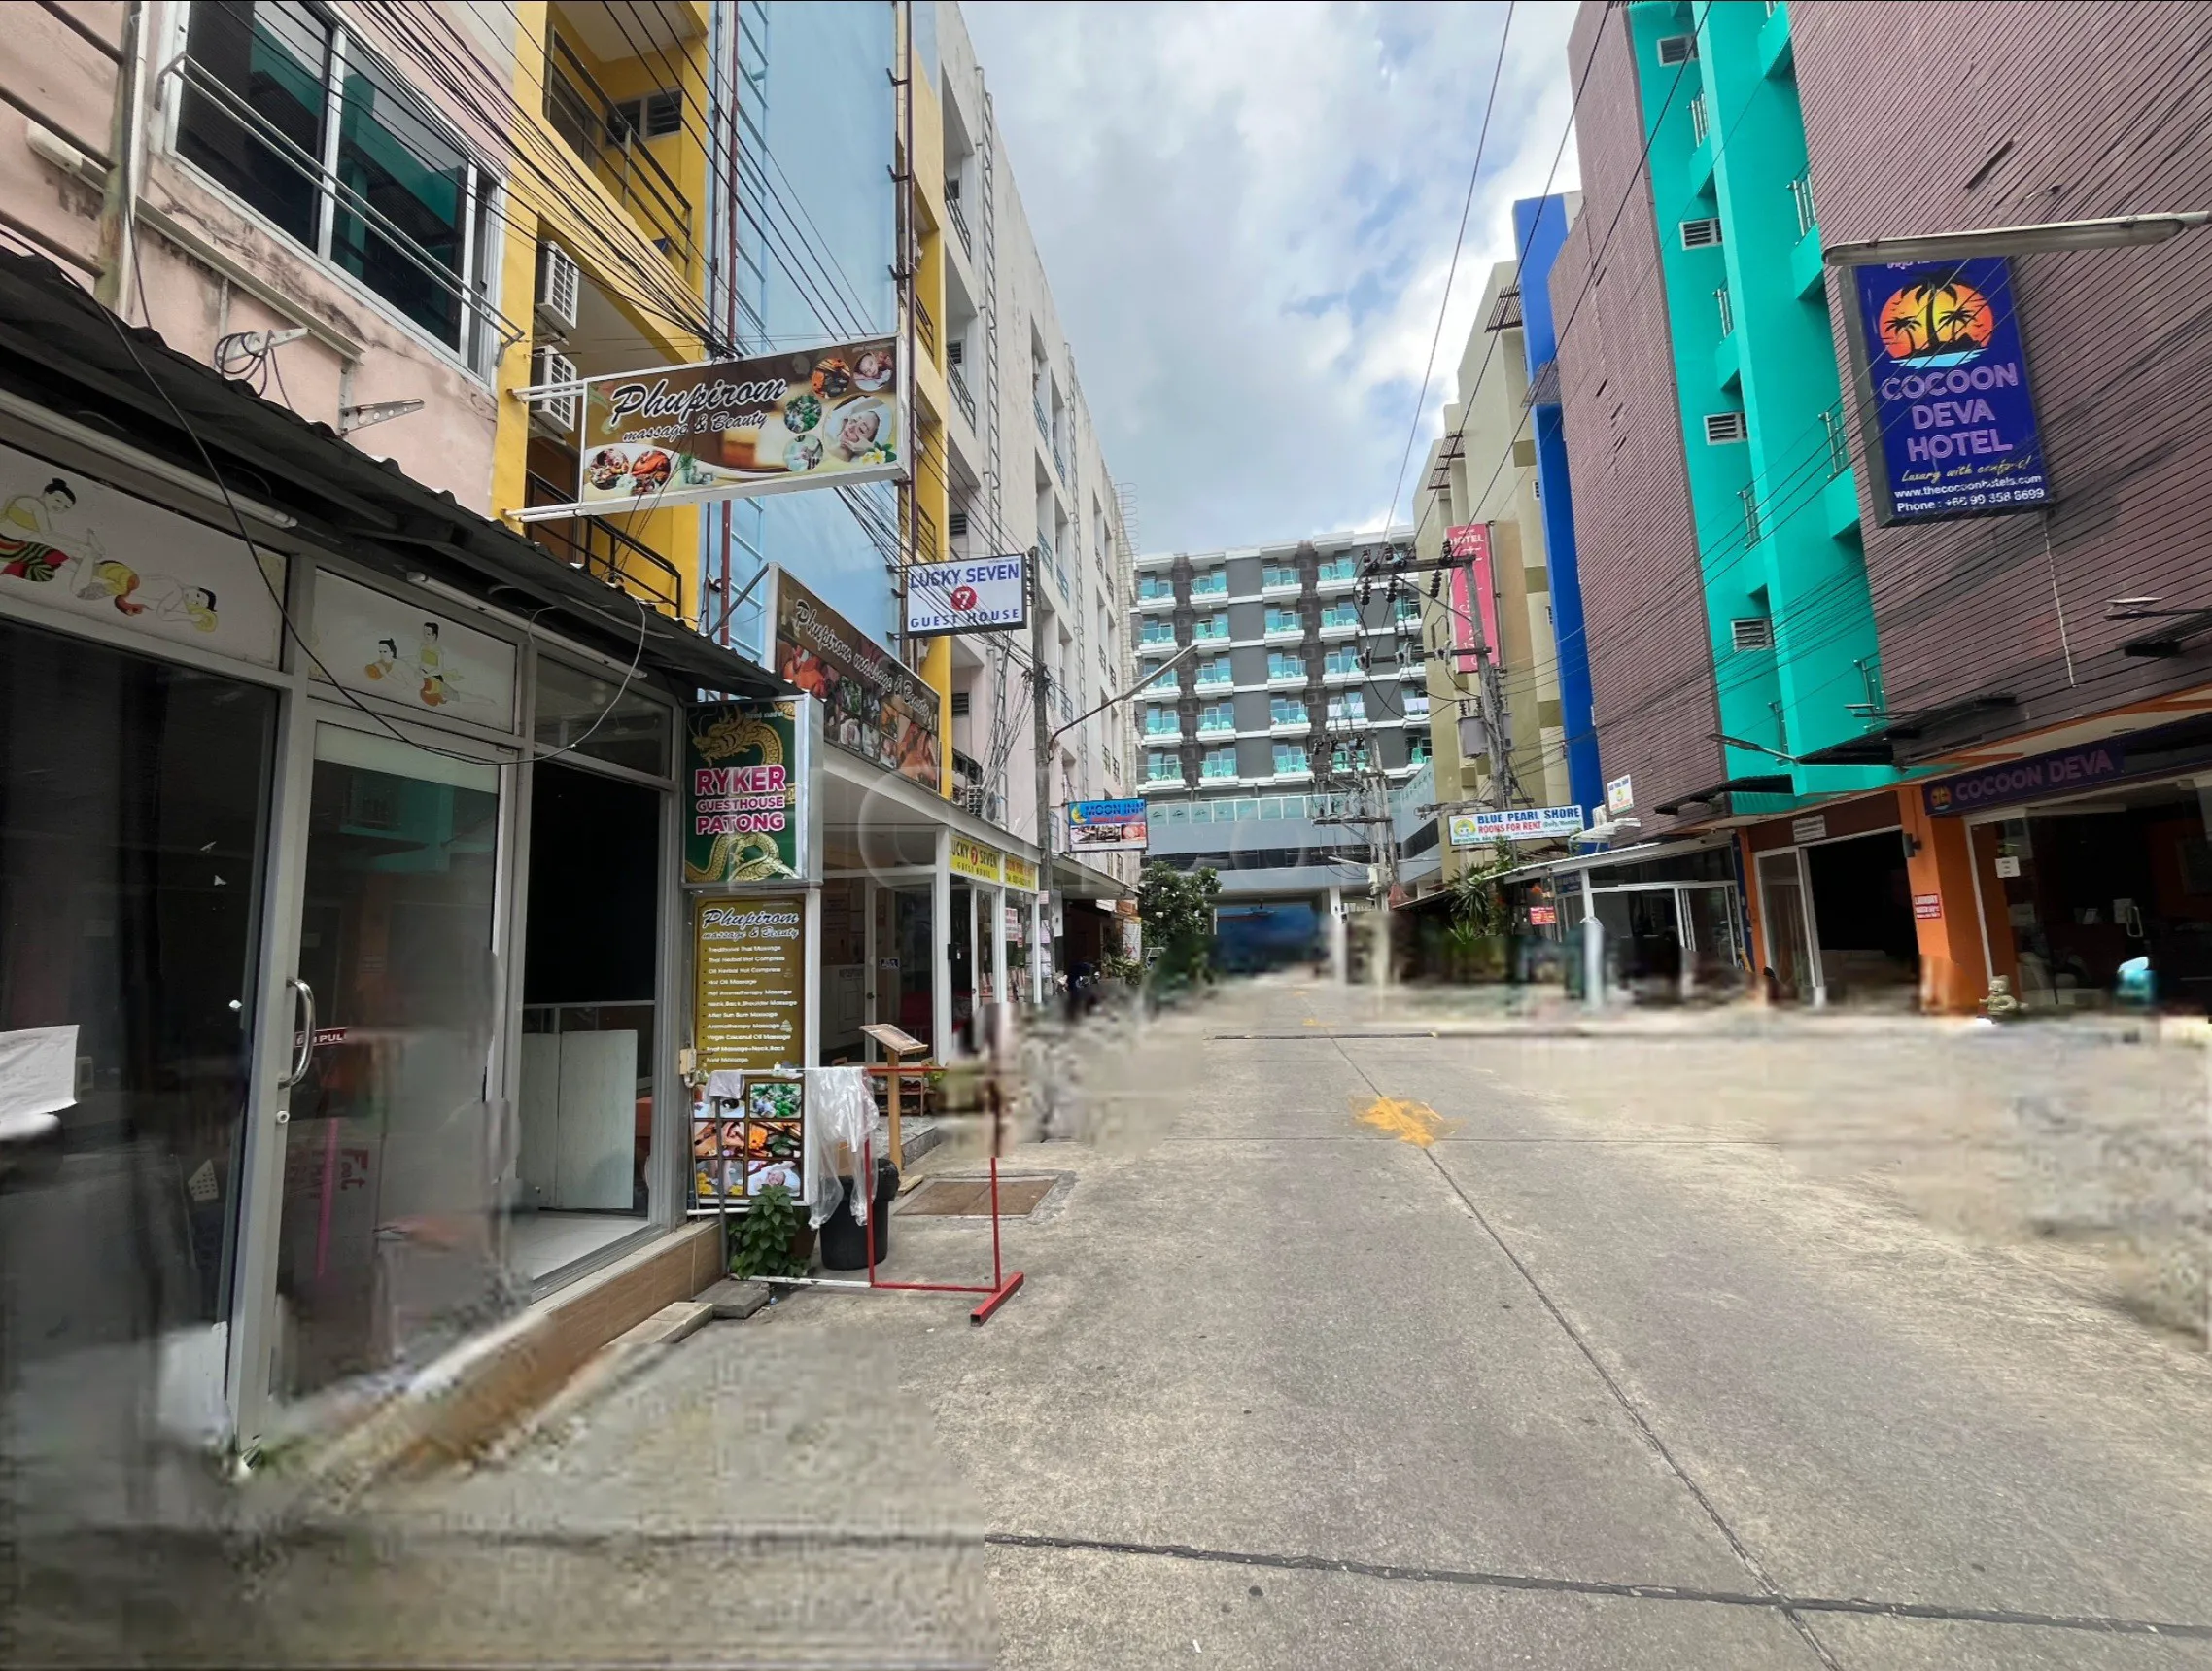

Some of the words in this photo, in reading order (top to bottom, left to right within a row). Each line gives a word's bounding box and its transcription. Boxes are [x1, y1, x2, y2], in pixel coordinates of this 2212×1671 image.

[1881, 362, 2019, 400] COCOON
[610, 378, 788, 426] Phupirom
[1911, 399, 1996, 429] DEVA
[622, 422, 689, 443] massage
[694, 413, 709, 434] &
[710, 409, 768, 431] Beauty
[1907, 429, 2014, 462] HOTEL
[1897, 501, 1936, 512] Phone
[910, 569, 961, 589] LUCKY
[966, 563, 1020, 583] SEVEN
[911, 614, 959, 628] GUEST
[968, 609, 1020, 624] HOUSE
[696, 765, 786, 795] RYKER
[1955, 764, 2043, 801] COCOON
[2048, 749, 2115, 783] DEVA
[697, 796, 785, 813] GUESTHOUSE
[1085, 803, 1122, 815] MOON
[1477, 813, 1503, 824] BLUE
[1507, 810, 1539, 822] PEARL
[1544, 808, 1580, 819] SHORE
[696, 812, 785, 835] PATONG
[1478, 823, 1505, 834] ROOMS
[1506, 822, 1521, 832] FOR
[1523, 820, 1542, 831] RENT
[950, 839, 970, 860] UCKY
[702, 907, 799, 930] Phupirom
[319, 1033, 347, 1042] PUL
